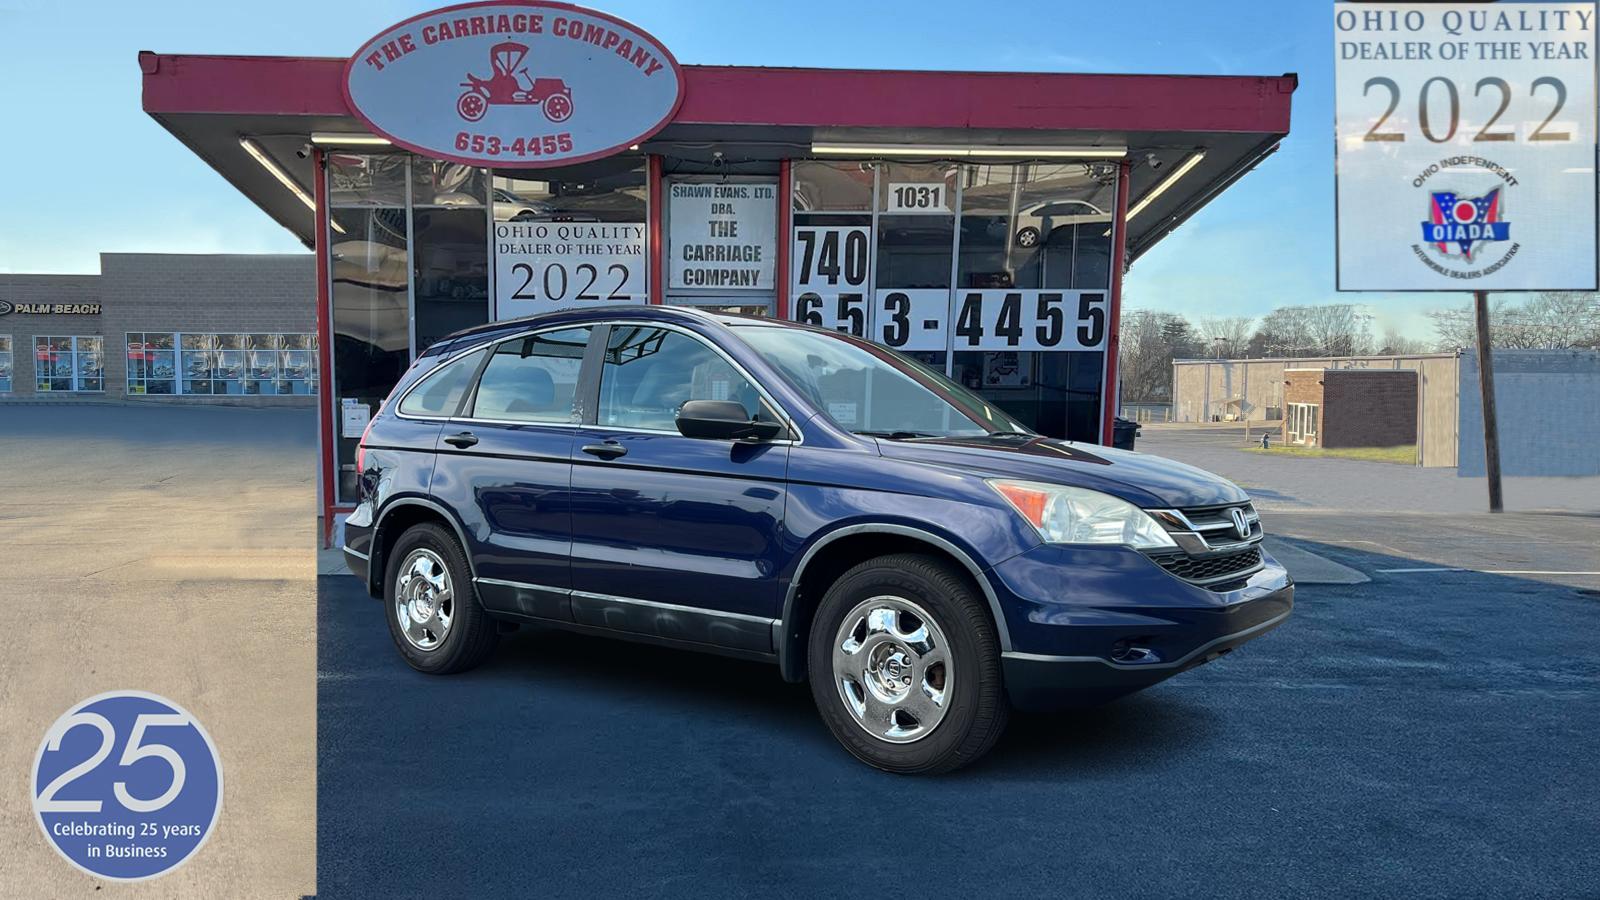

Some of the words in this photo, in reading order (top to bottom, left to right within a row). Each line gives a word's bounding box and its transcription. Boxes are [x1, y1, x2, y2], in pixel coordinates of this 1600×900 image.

[1336, 10, 1425, 31] OHIO
[1442, 10, 1592, 35] QUALITY
[366, 34, 416, 71] THE
[422, 14, 543, 45] CARRIAGE
[552, 17, 664, 77] COMPANY
[1340, 42, 1432, 60] DEALER
[1439, 42, 1469, 60] OF
[1475, 42, 1522, 60] THE
[1528, 42, 1588, 60] YEAR
[1363, 76, 1571, 143] 2022
[455, 132, 572, 156] 653-4455
[1412, 164, 1439, 188] OHIO
[1440, 155, 1519, 188] INDEPENDENT
[672, 186, 712, 199] SHAWN
[754, 187, 774, 199] LTD.
[894, 187, 940, 208] 1031
[711, 203, 735, 215] DBA.
[497, 226, 548, 239] OHIO
[558, 226, 643, 241] QUALITY
[708, 220, 738, 237] THE
[1432, 224, 1495, 241] OIADA
[499, 244, 551, 255] DEALER
[555, 244, 573, 255] OF
[576, 244, 603, 255] THE
[606, 245, 641, 255] YEAR
[683, 245, 762, 262] CARRIAGE
[798, 230, 868, 286] 740
[511, 263, 631, 301] 2022
[683, 269, 760, 286] COMPANY
[15, 304, 50, 314] PALM
[54, 304, 100, 314] BEACH
